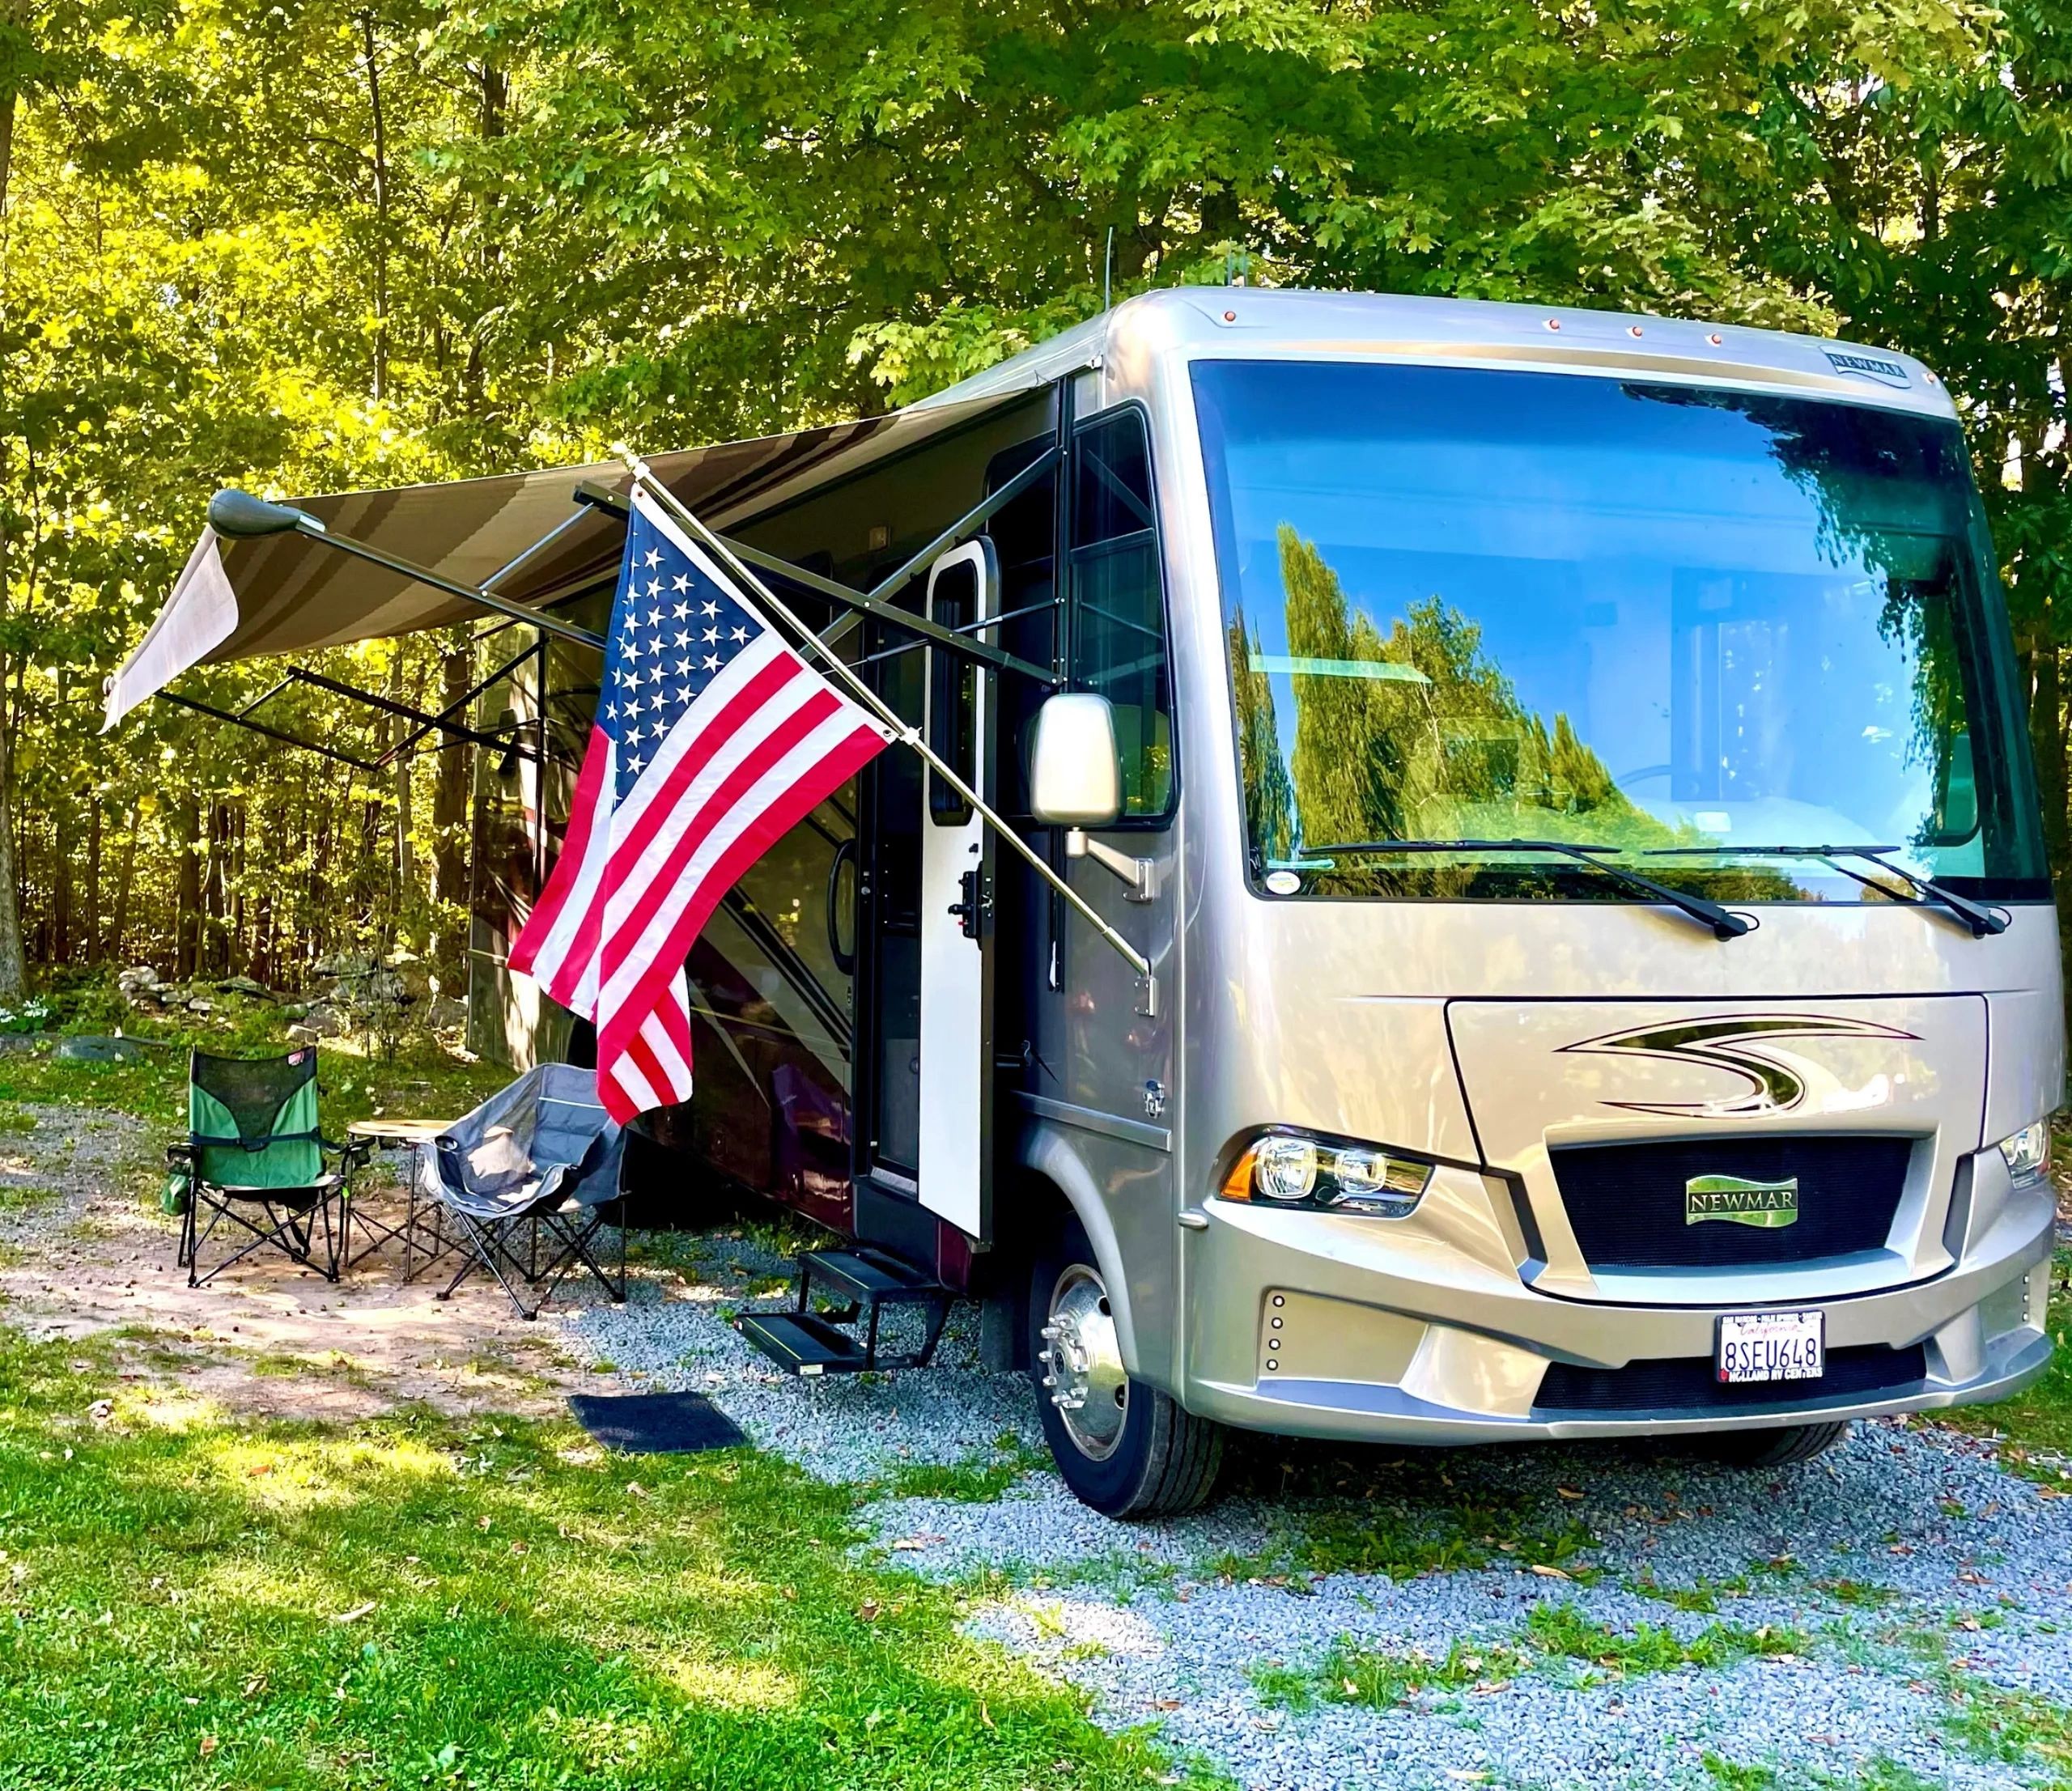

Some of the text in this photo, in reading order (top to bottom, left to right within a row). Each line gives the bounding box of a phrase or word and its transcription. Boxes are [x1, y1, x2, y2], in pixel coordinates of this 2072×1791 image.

[1830, 354, 1904, 377] NEWMAR
[1689, 1191, 1797, 1212] NEWMAR
[1740, 1323, 1798, 1339] California
[1725, 1338, 1816, 1370] 8SEU648
[1729, 1367, 1823, 1382] HOLLAND RV CENTERS
